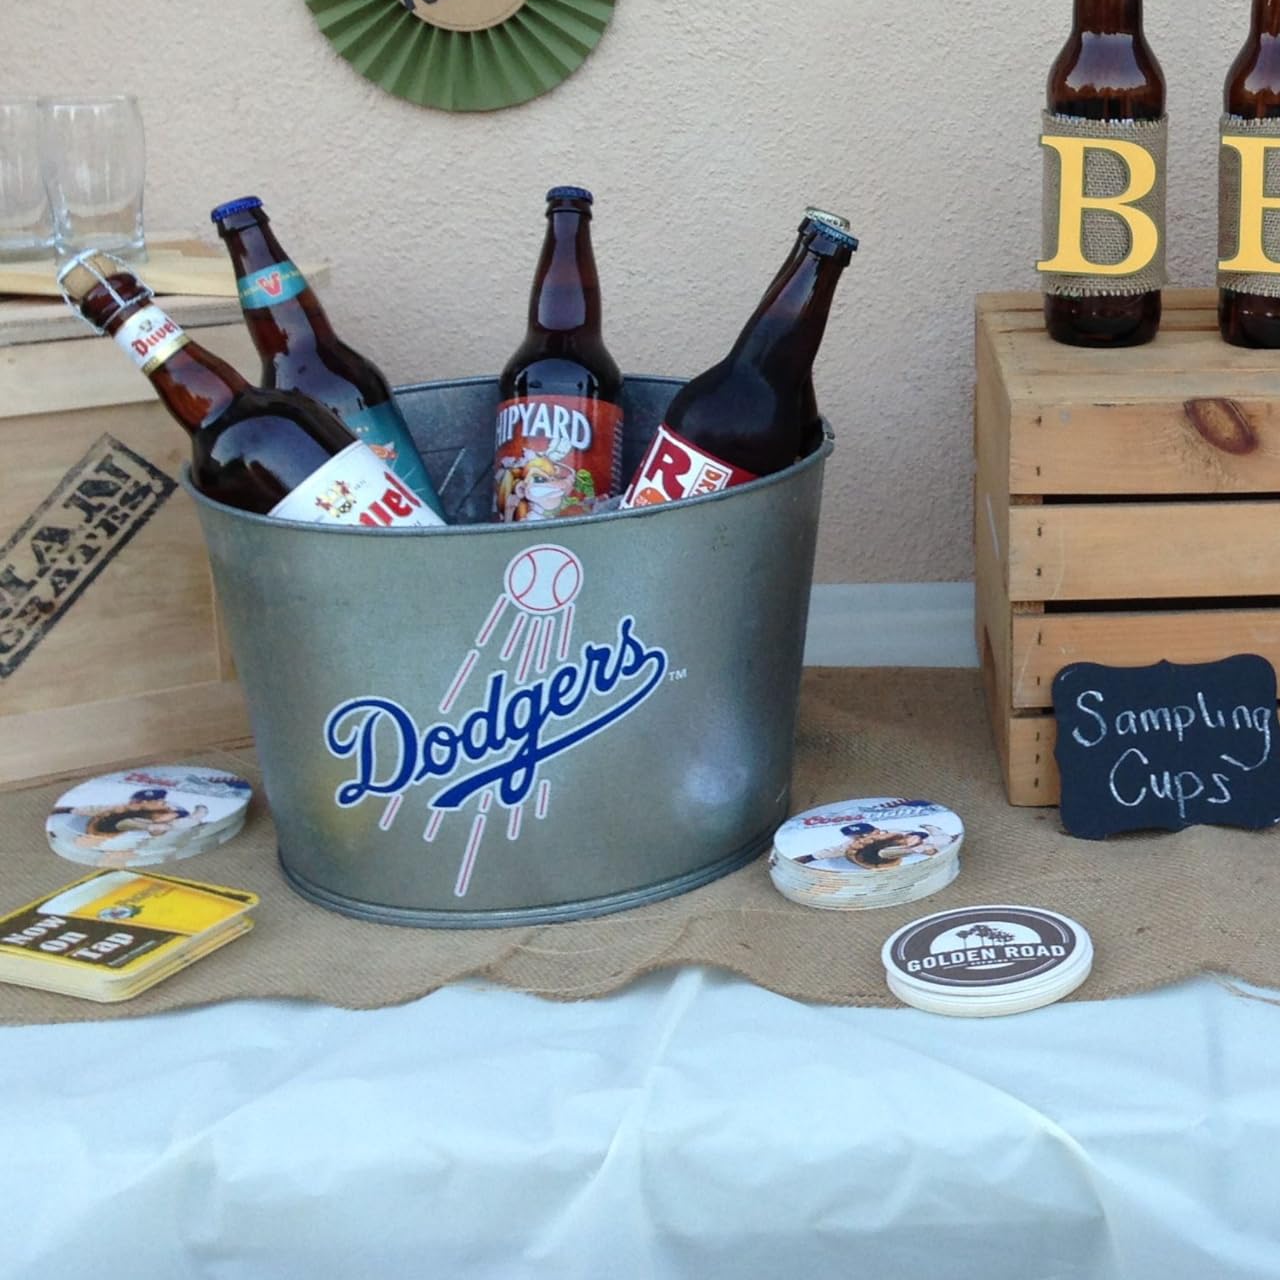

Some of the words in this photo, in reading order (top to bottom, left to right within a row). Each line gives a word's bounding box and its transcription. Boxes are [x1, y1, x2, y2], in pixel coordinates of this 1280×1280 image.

[131, 317, 178, 357] Duvel
[325, 613, 669, 810] Dodgers
[1071, 689, 1272, 771] Sampling
[1109, 748, 1232, 819] Cups
[907, 947, 997, 972] GOLDEN
[1005, 944, 1066, 958] ROAD
